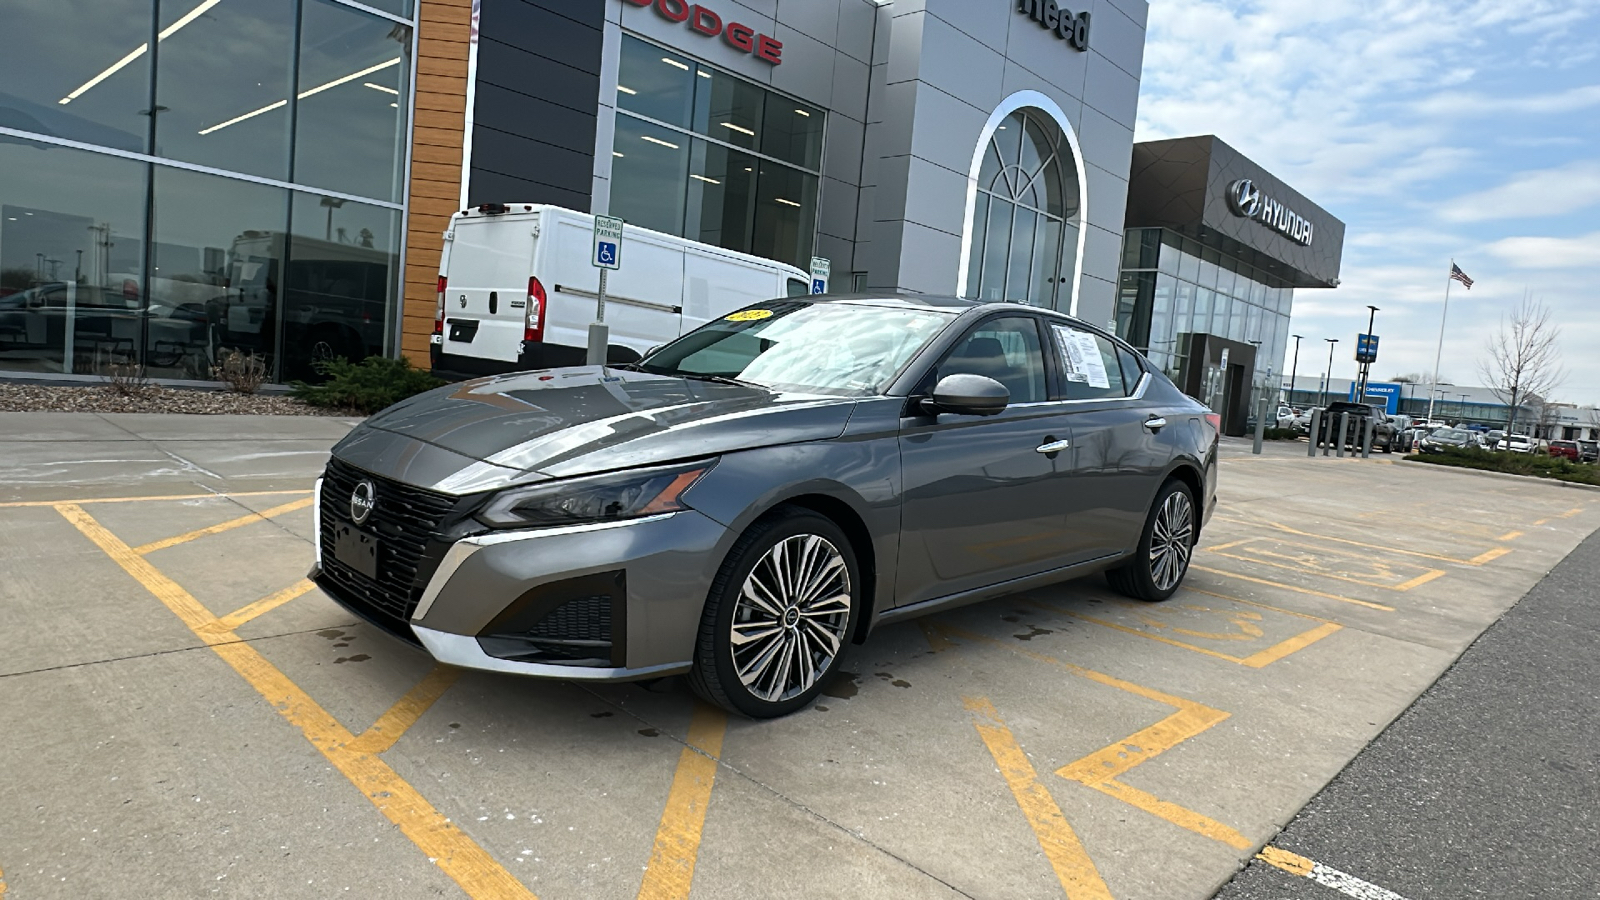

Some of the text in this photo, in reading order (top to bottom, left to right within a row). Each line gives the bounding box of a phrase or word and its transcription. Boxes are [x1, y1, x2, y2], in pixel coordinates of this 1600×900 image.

[625, 0, 784, 66] ODGE
[597, 228, 620, 239] PARKING
[598, 220, 620, 230] RESERVED
[1262, 194, 1314, 247] HYUNDAI
